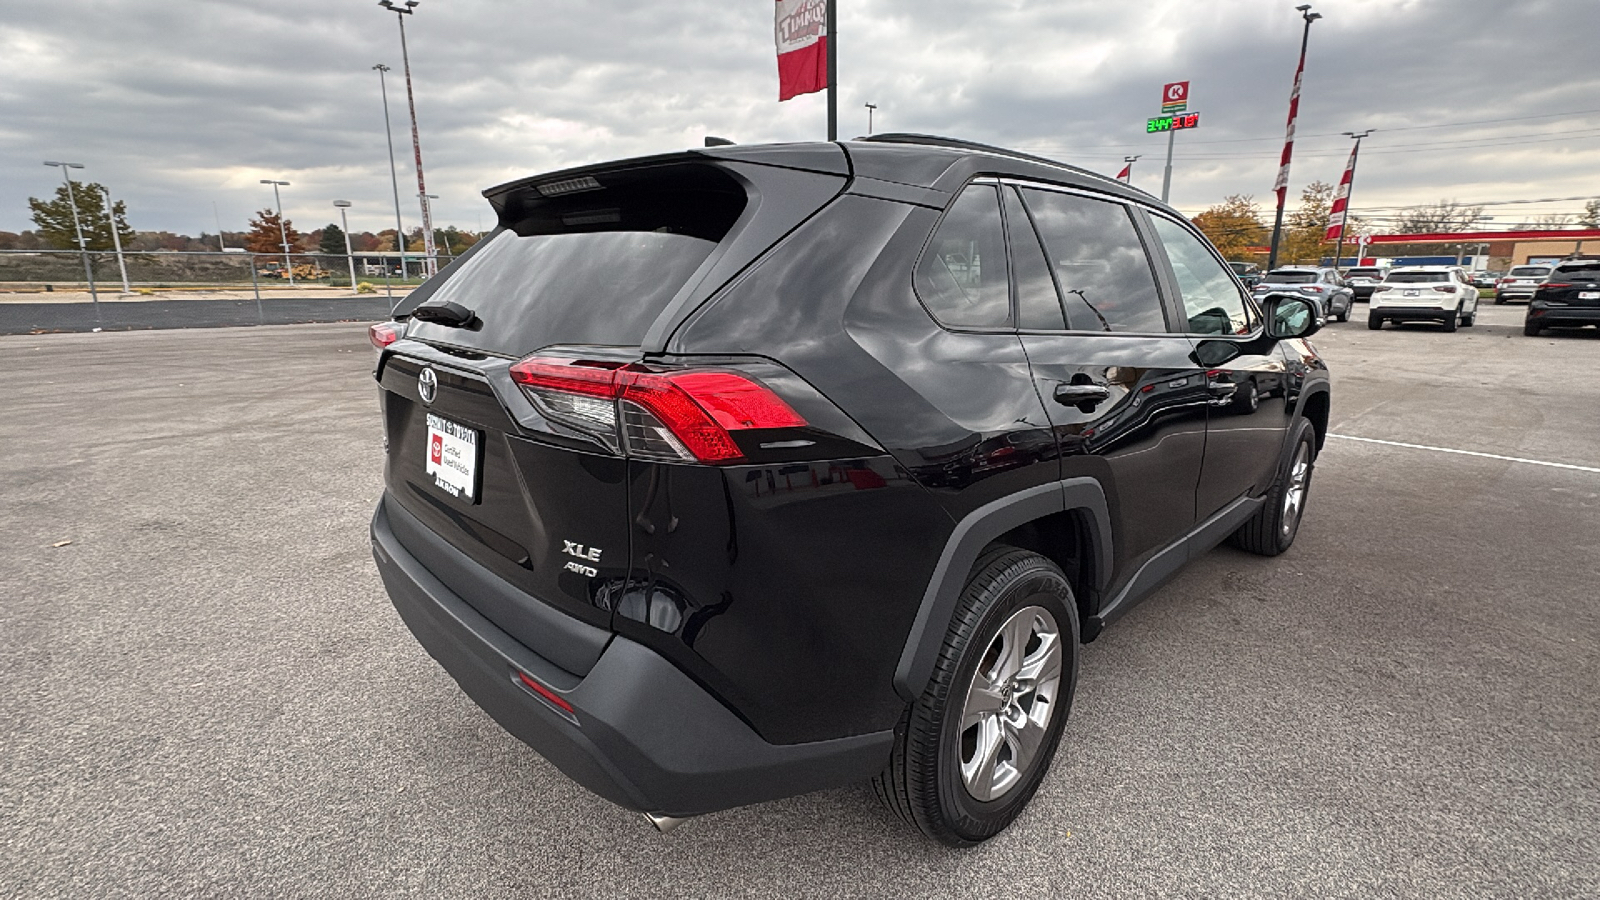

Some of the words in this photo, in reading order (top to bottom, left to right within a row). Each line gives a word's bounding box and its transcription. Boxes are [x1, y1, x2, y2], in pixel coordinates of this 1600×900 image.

[434, 477, 459, 498] AKRON
[561, 539, 603, 562] XLE
[563, 561, 598, 577] AWD
